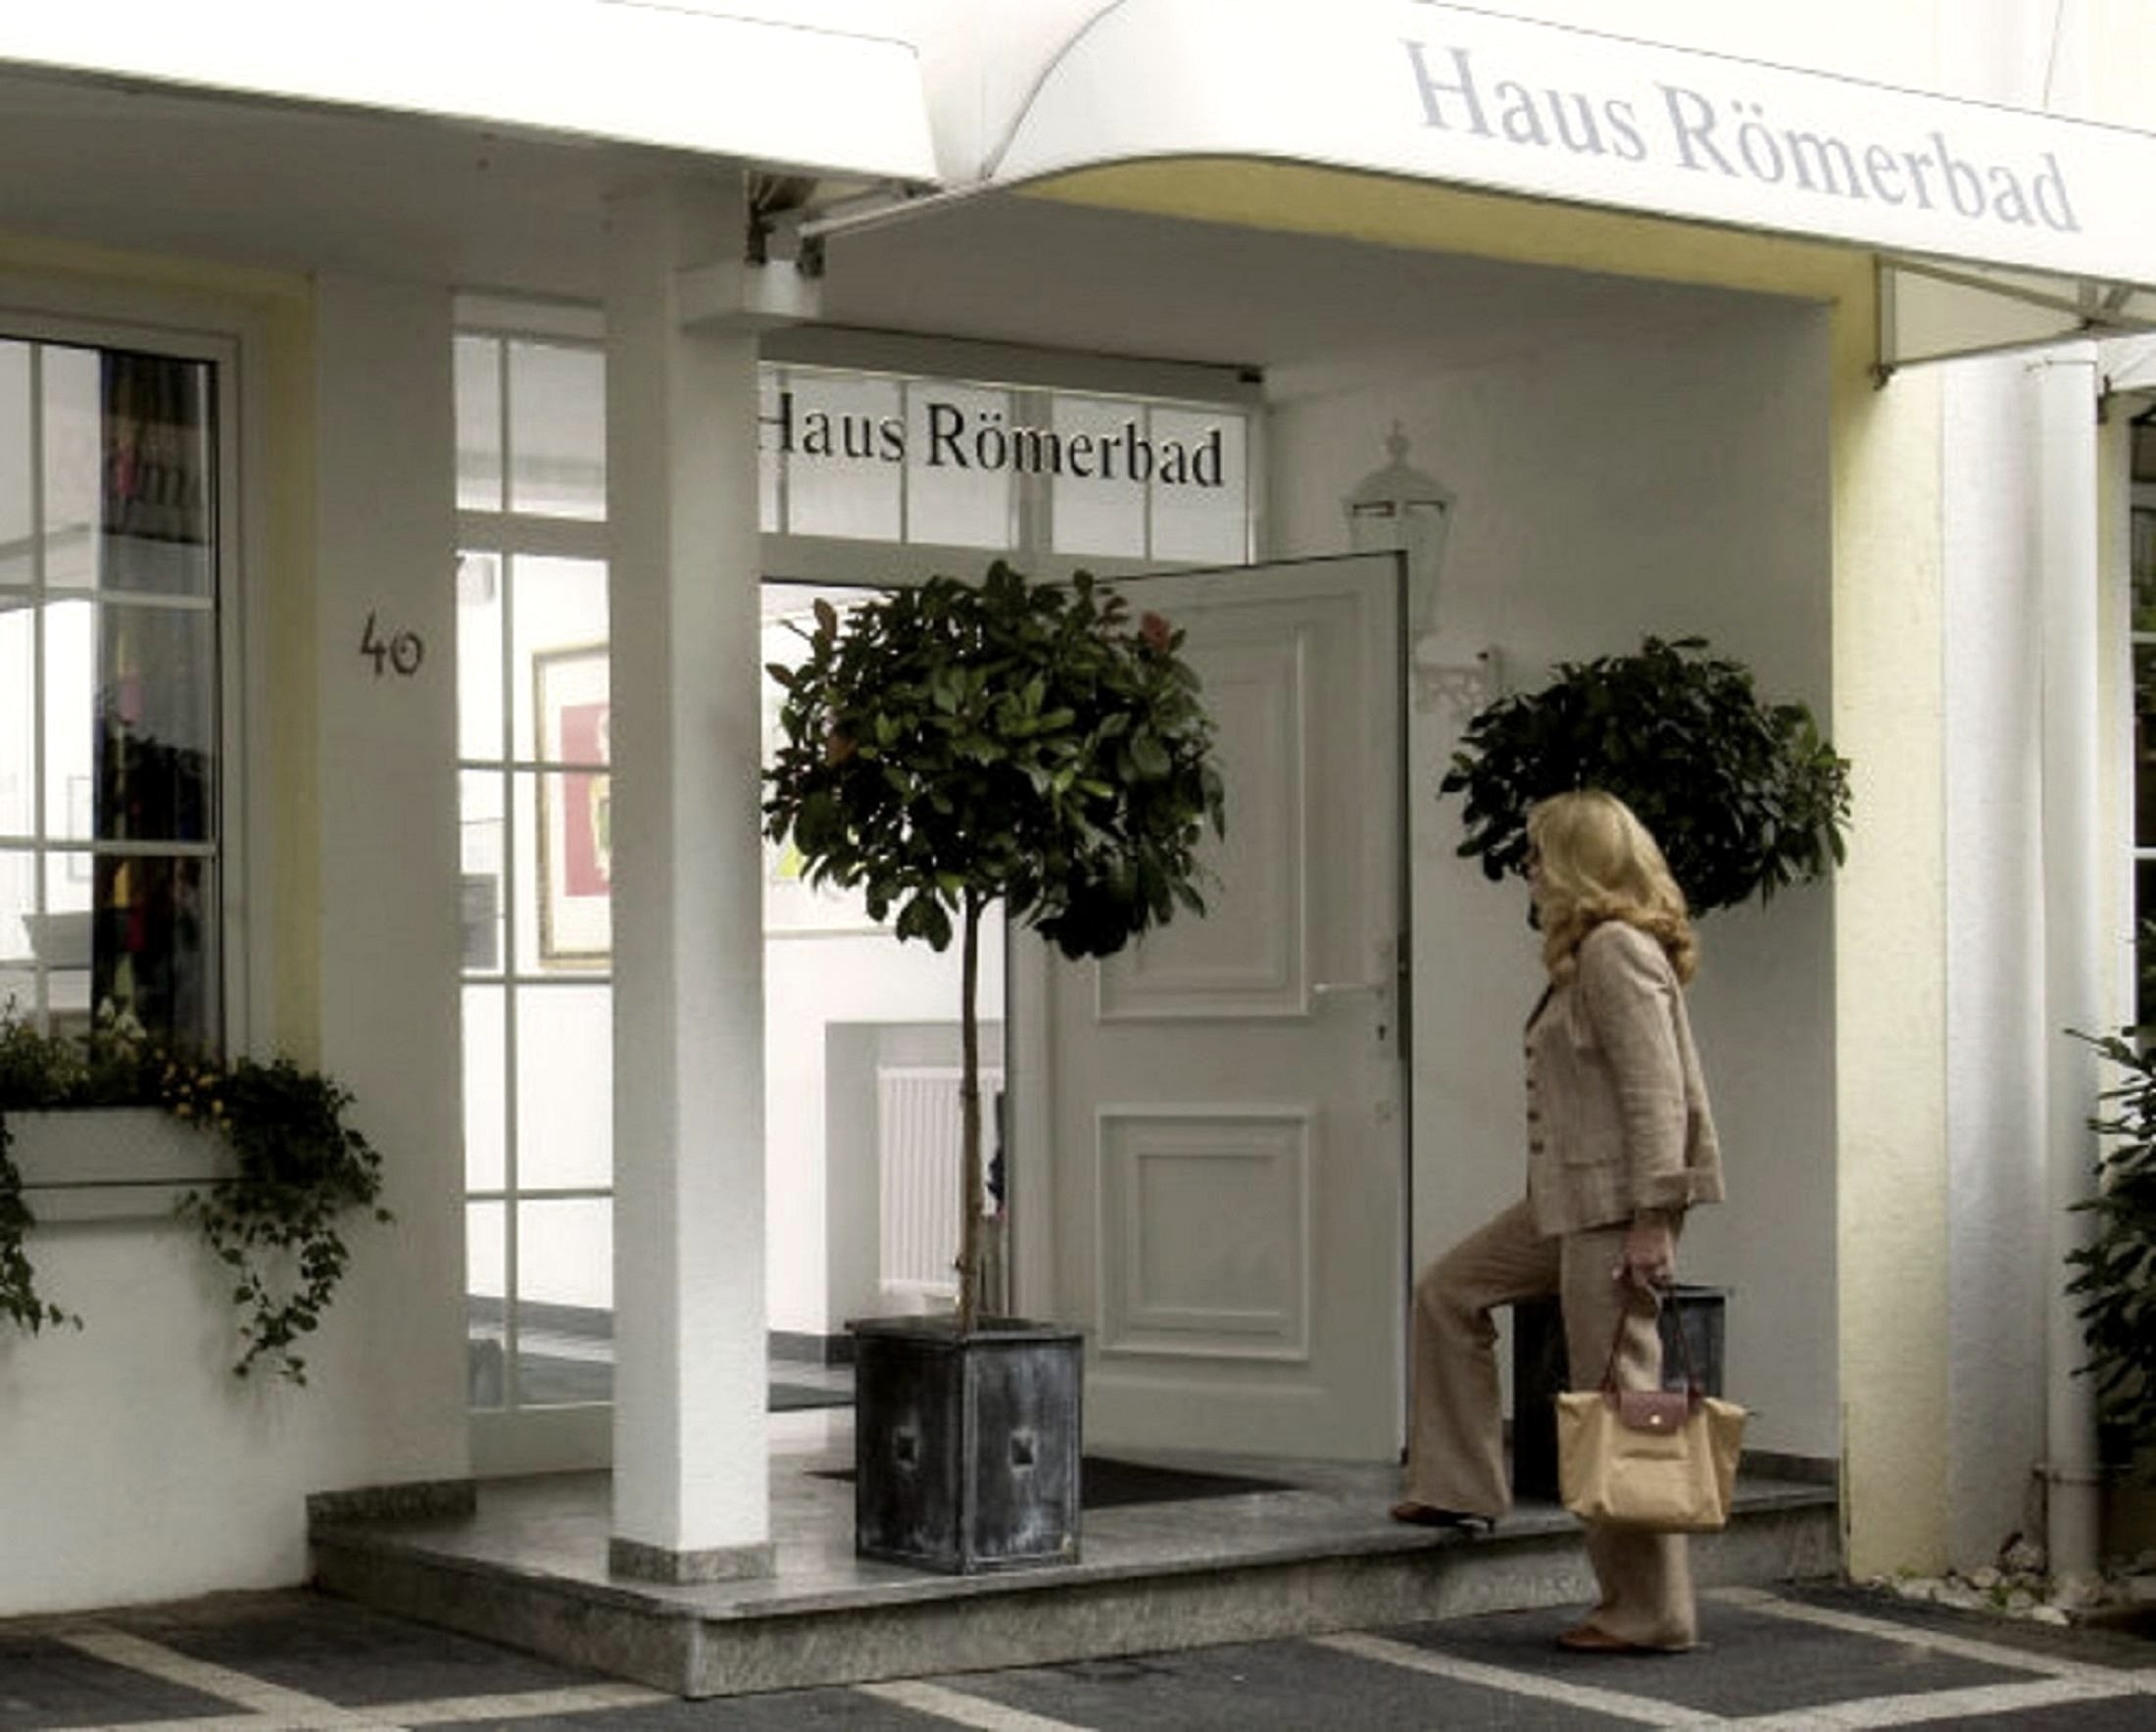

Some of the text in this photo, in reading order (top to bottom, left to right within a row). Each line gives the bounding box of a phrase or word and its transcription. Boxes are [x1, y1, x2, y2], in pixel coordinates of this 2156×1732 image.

[1401, 39, 2082, 233] Haus Römerbad
[926, 403, 1225, 488] Römerbad
[361, 608, 423, 677] 40
